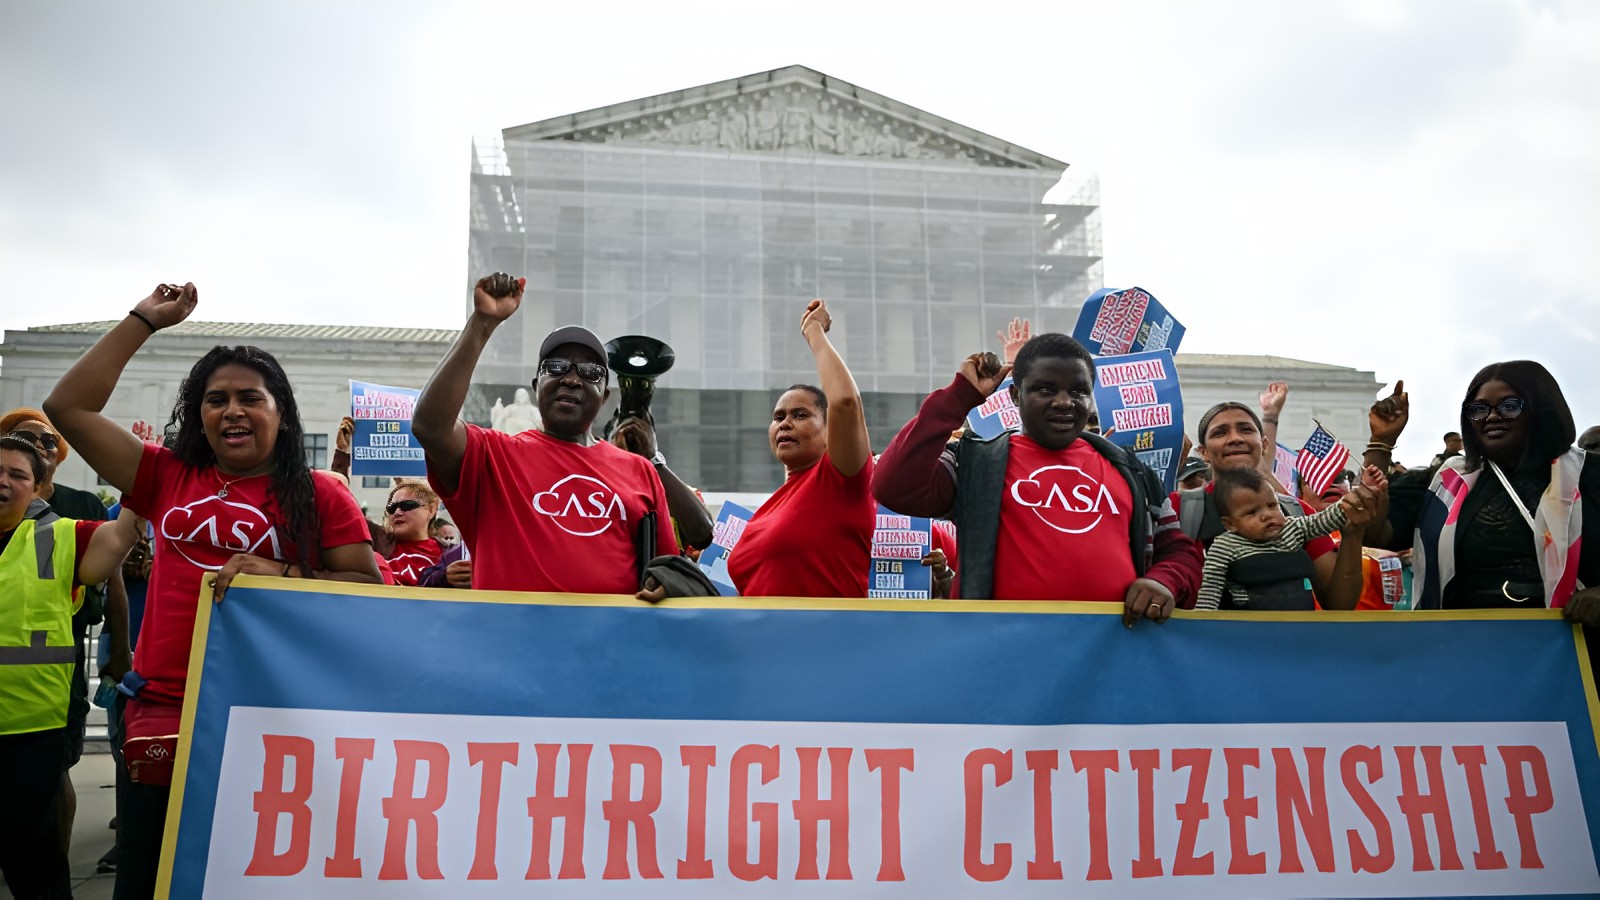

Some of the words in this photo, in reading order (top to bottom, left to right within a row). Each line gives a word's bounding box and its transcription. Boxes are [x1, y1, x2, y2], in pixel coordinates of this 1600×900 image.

[532, 491, 627, 521] CASA
[1010, 479, 1120, 515] CASA
[161, 506, 283, 560] CASA
[244, 734, 915, 882] BIRTHRIGHT
[963, 744, 1554, 882] CITIZENSHIP
